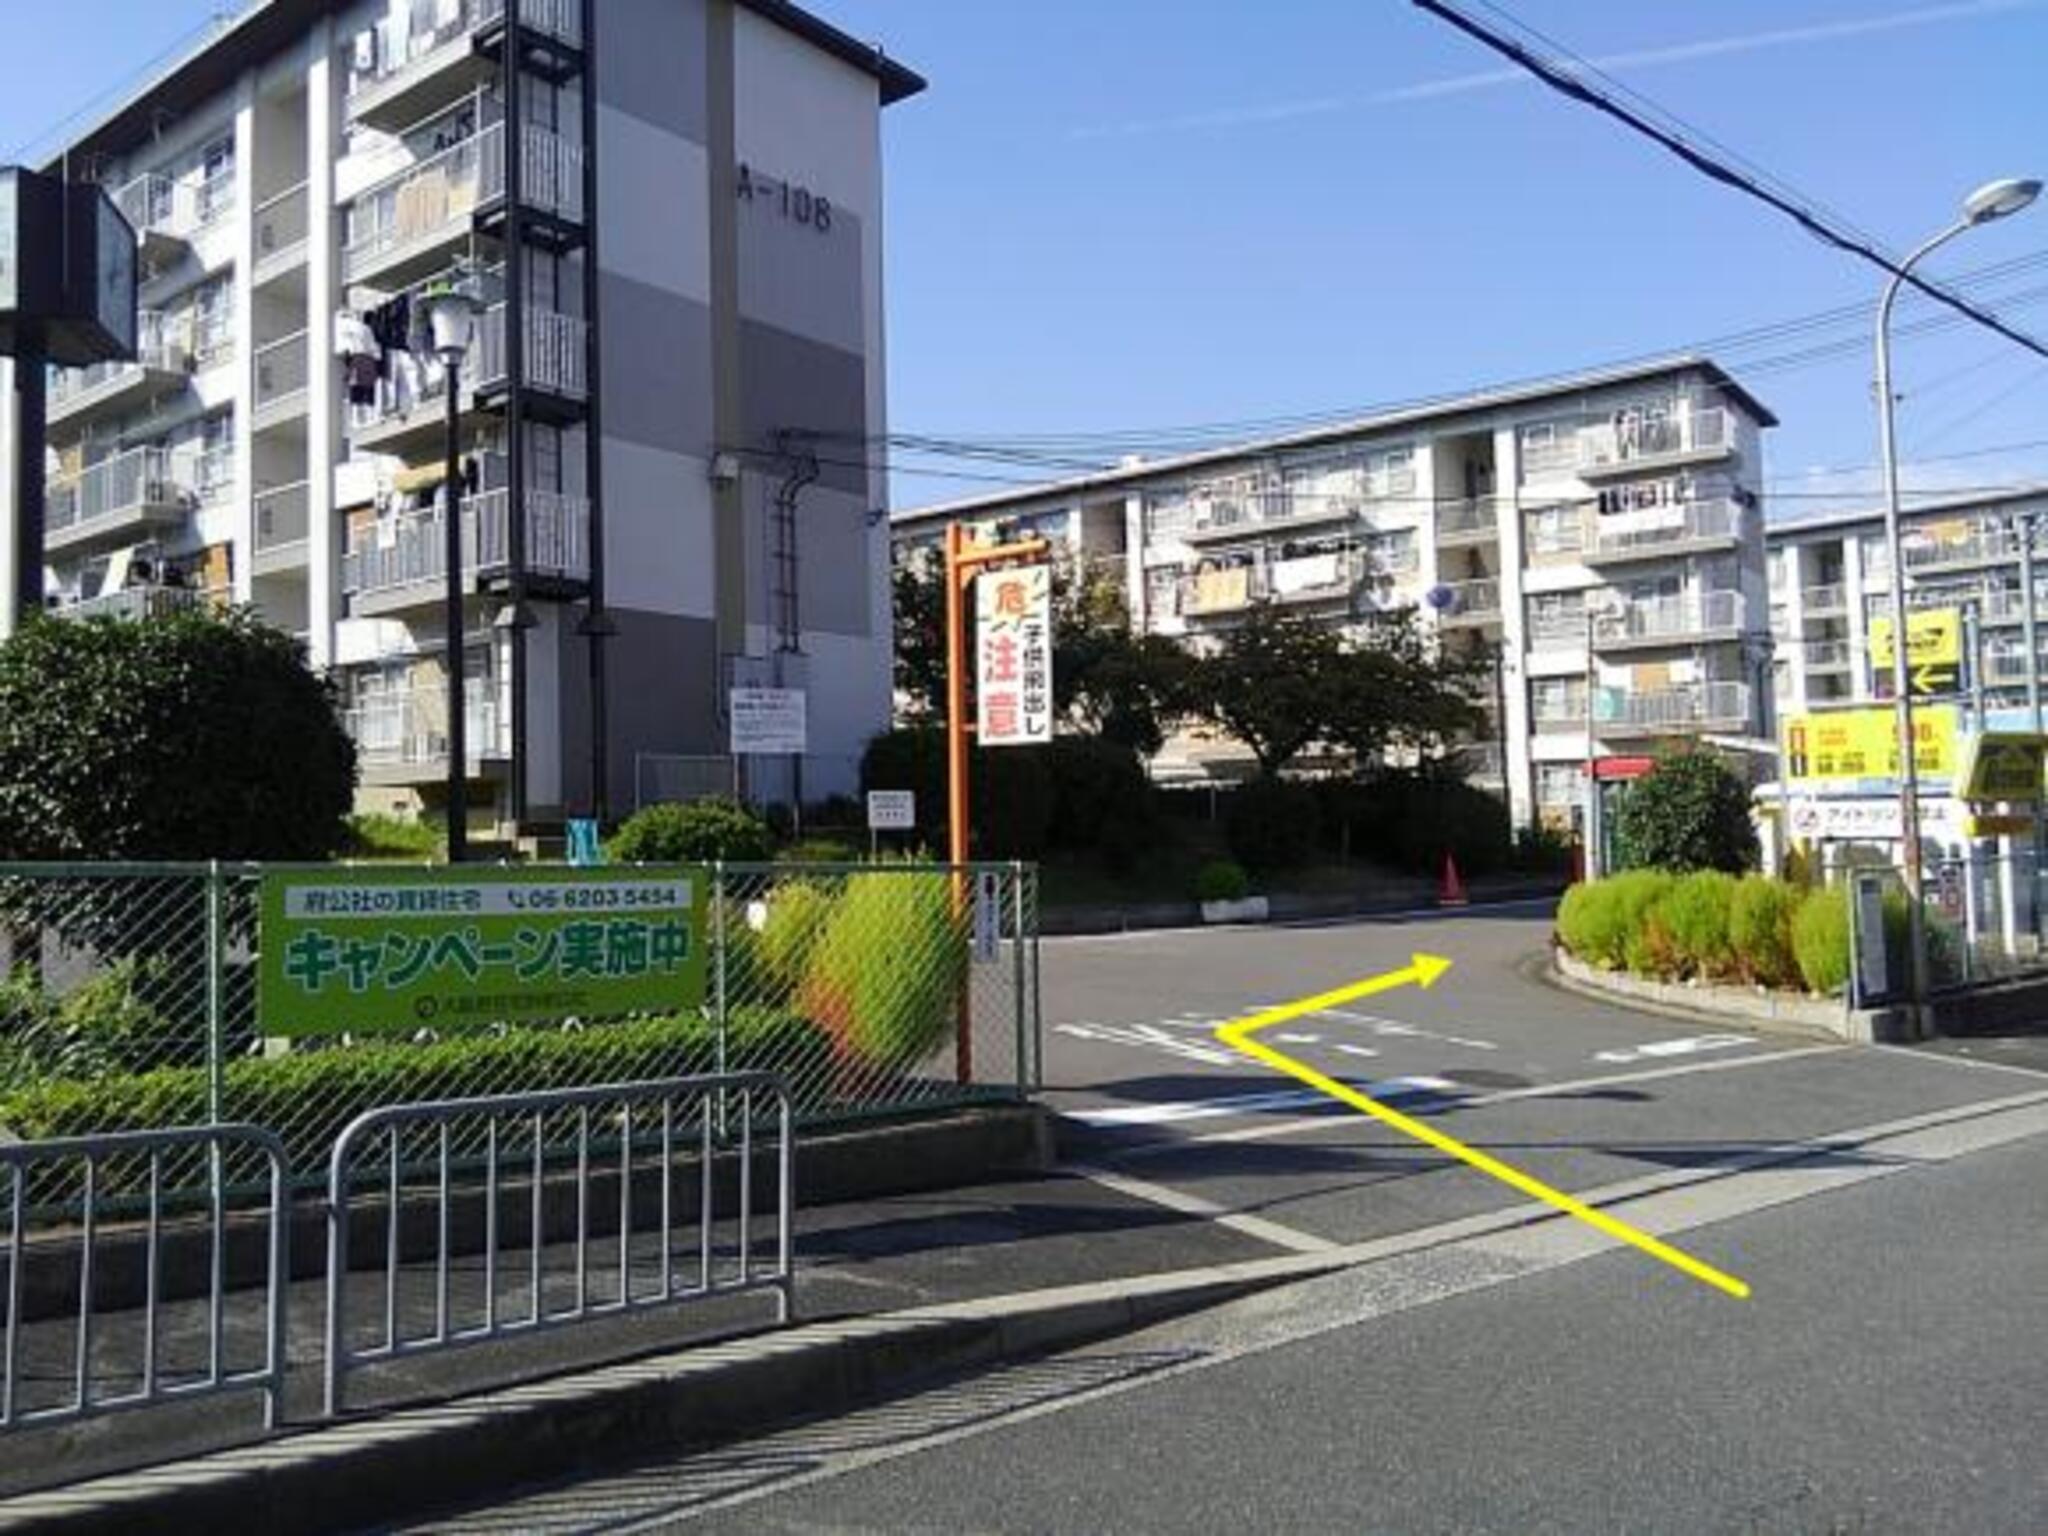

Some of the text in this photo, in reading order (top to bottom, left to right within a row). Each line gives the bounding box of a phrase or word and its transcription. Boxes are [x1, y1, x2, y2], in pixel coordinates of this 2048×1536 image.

[285, 918, 690, 991] キャンペーン実施中
